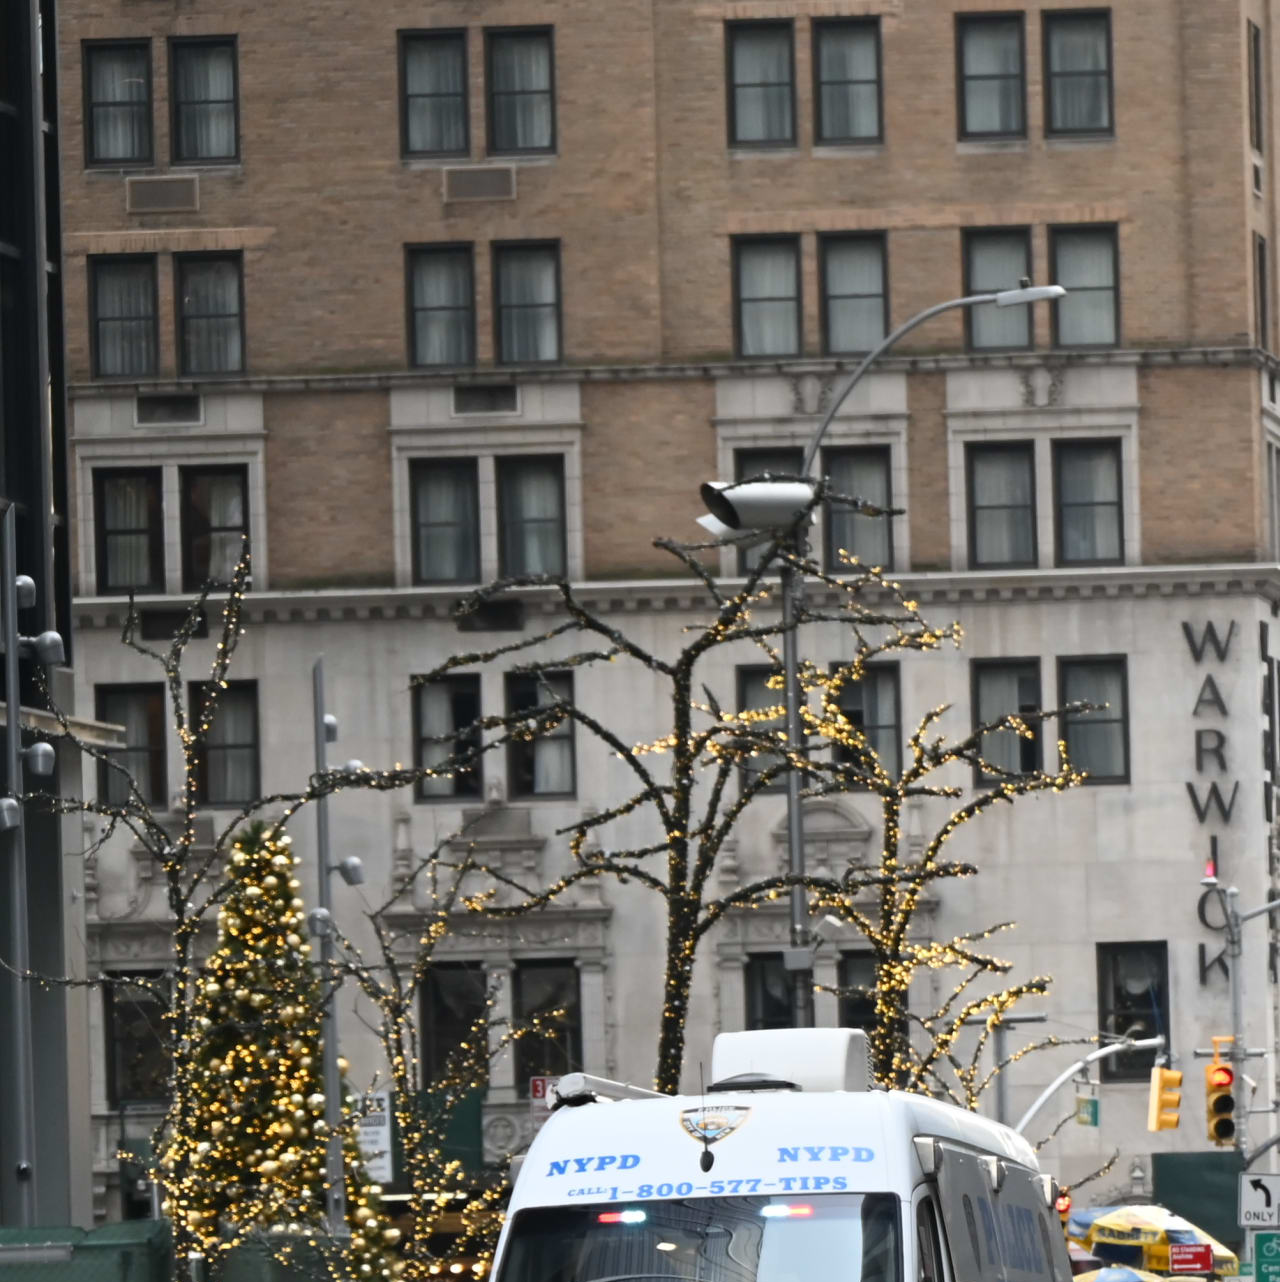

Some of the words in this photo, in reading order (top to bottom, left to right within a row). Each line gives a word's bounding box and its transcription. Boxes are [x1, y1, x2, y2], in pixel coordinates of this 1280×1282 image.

[1181, 620, 1239, 986] WARWICK
[535, 1081, 544, 1097] 3
[777, 1146, 875, 1163] NYPD
[546, 1154, 641, 1177] NYPD
[608, 1176, 848, 1200] 1-800-577-TIPS
[1244, 1211, 1274, 1222] ONLY
